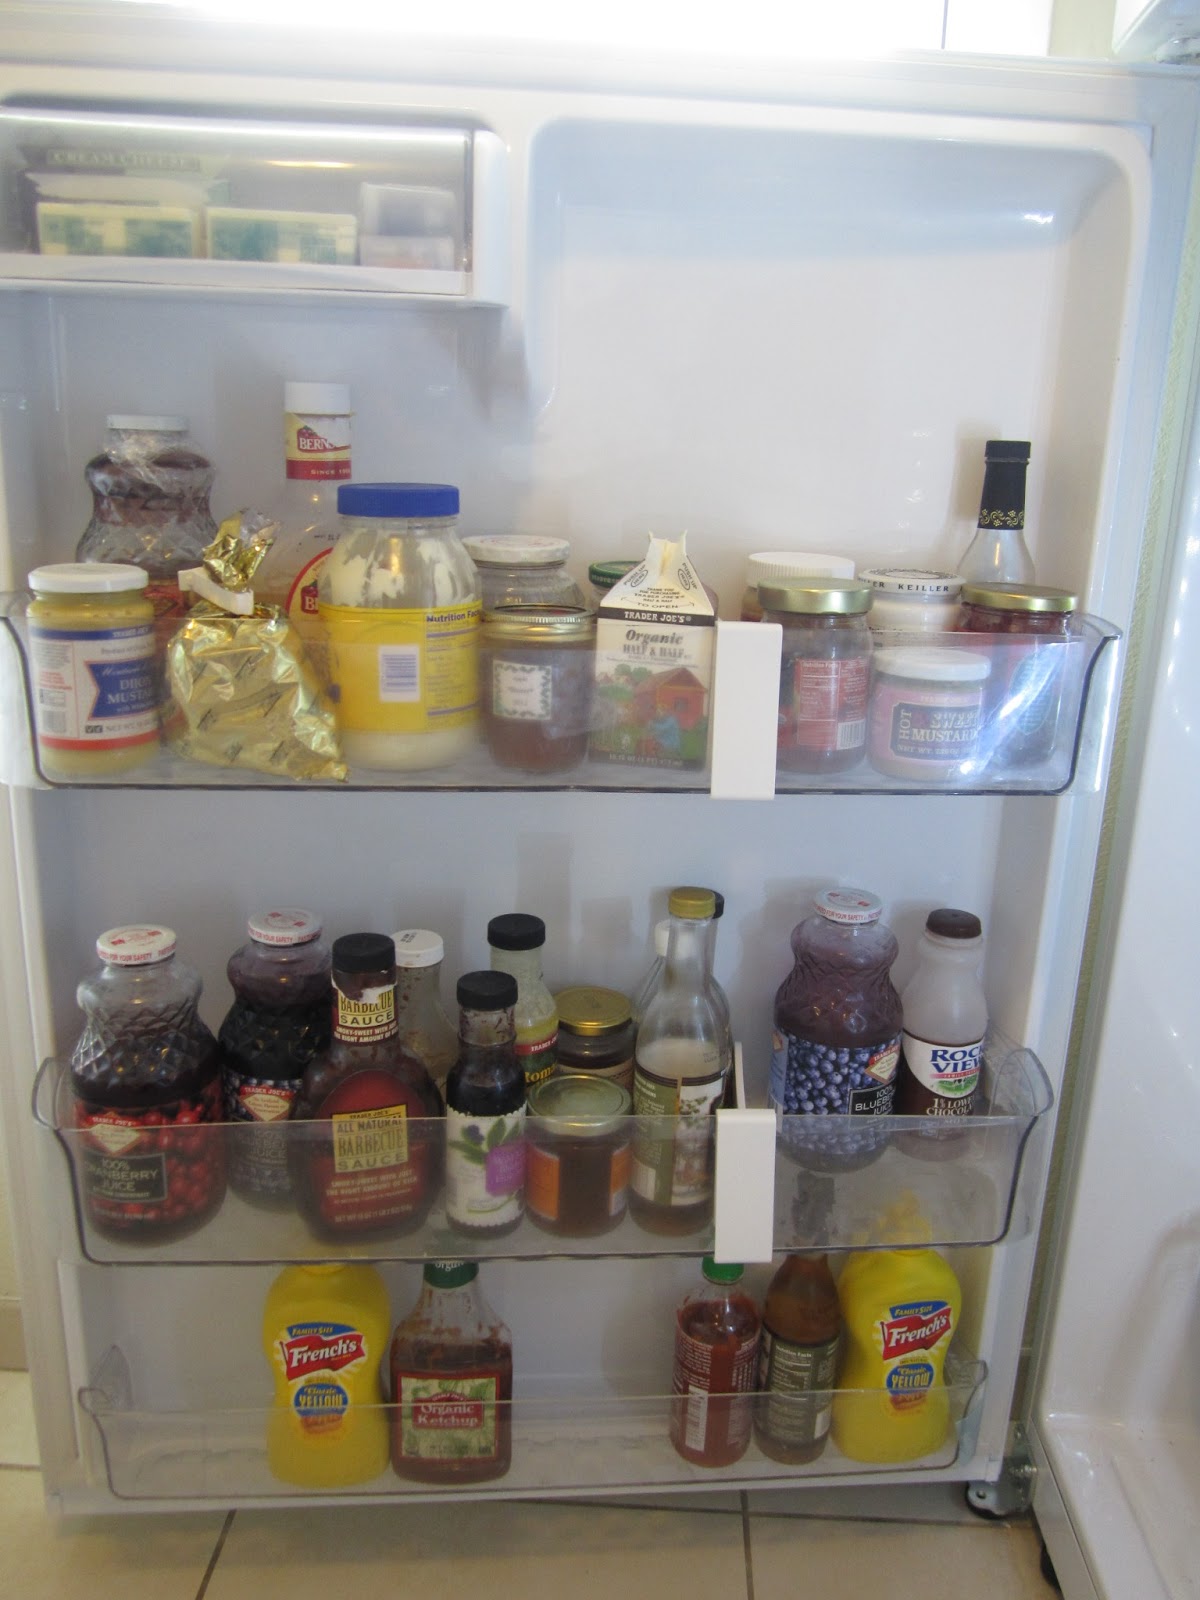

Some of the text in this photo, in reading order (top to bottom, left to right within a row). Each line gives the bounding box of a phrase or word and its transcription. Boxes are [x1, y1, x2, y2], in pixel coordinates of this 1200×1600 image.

[898, 583, 949, 592] KEILLER
[426, 611, 466, 623] Nutrition
[624, 611, 686, 623] TRADER JOE'S
[625, 628, 684, 645] Organic
[899, 708, 912, 740] HOT
[340, 1010, 393, 1025] SAUCE
[336, 1121, 354, 1134] ALL
[338, 1128, 404, 1158] BARBECUE
[102, 1158, 131, 1171] 100%
[337, 1152, 405, 1171] SAUCE
[102, 1180, 137, 1192] JUICE
[889, 1314, 948, 1348] French's
[289, 1338, 358, 1369] French's
[891, 1371, 931, 1390] YELLOW
[299, 1394, 344, 1410] YELLOW
[421, 1402, 475, 1416] Organic
[417, 1414, 478, 1428] Ketchup
